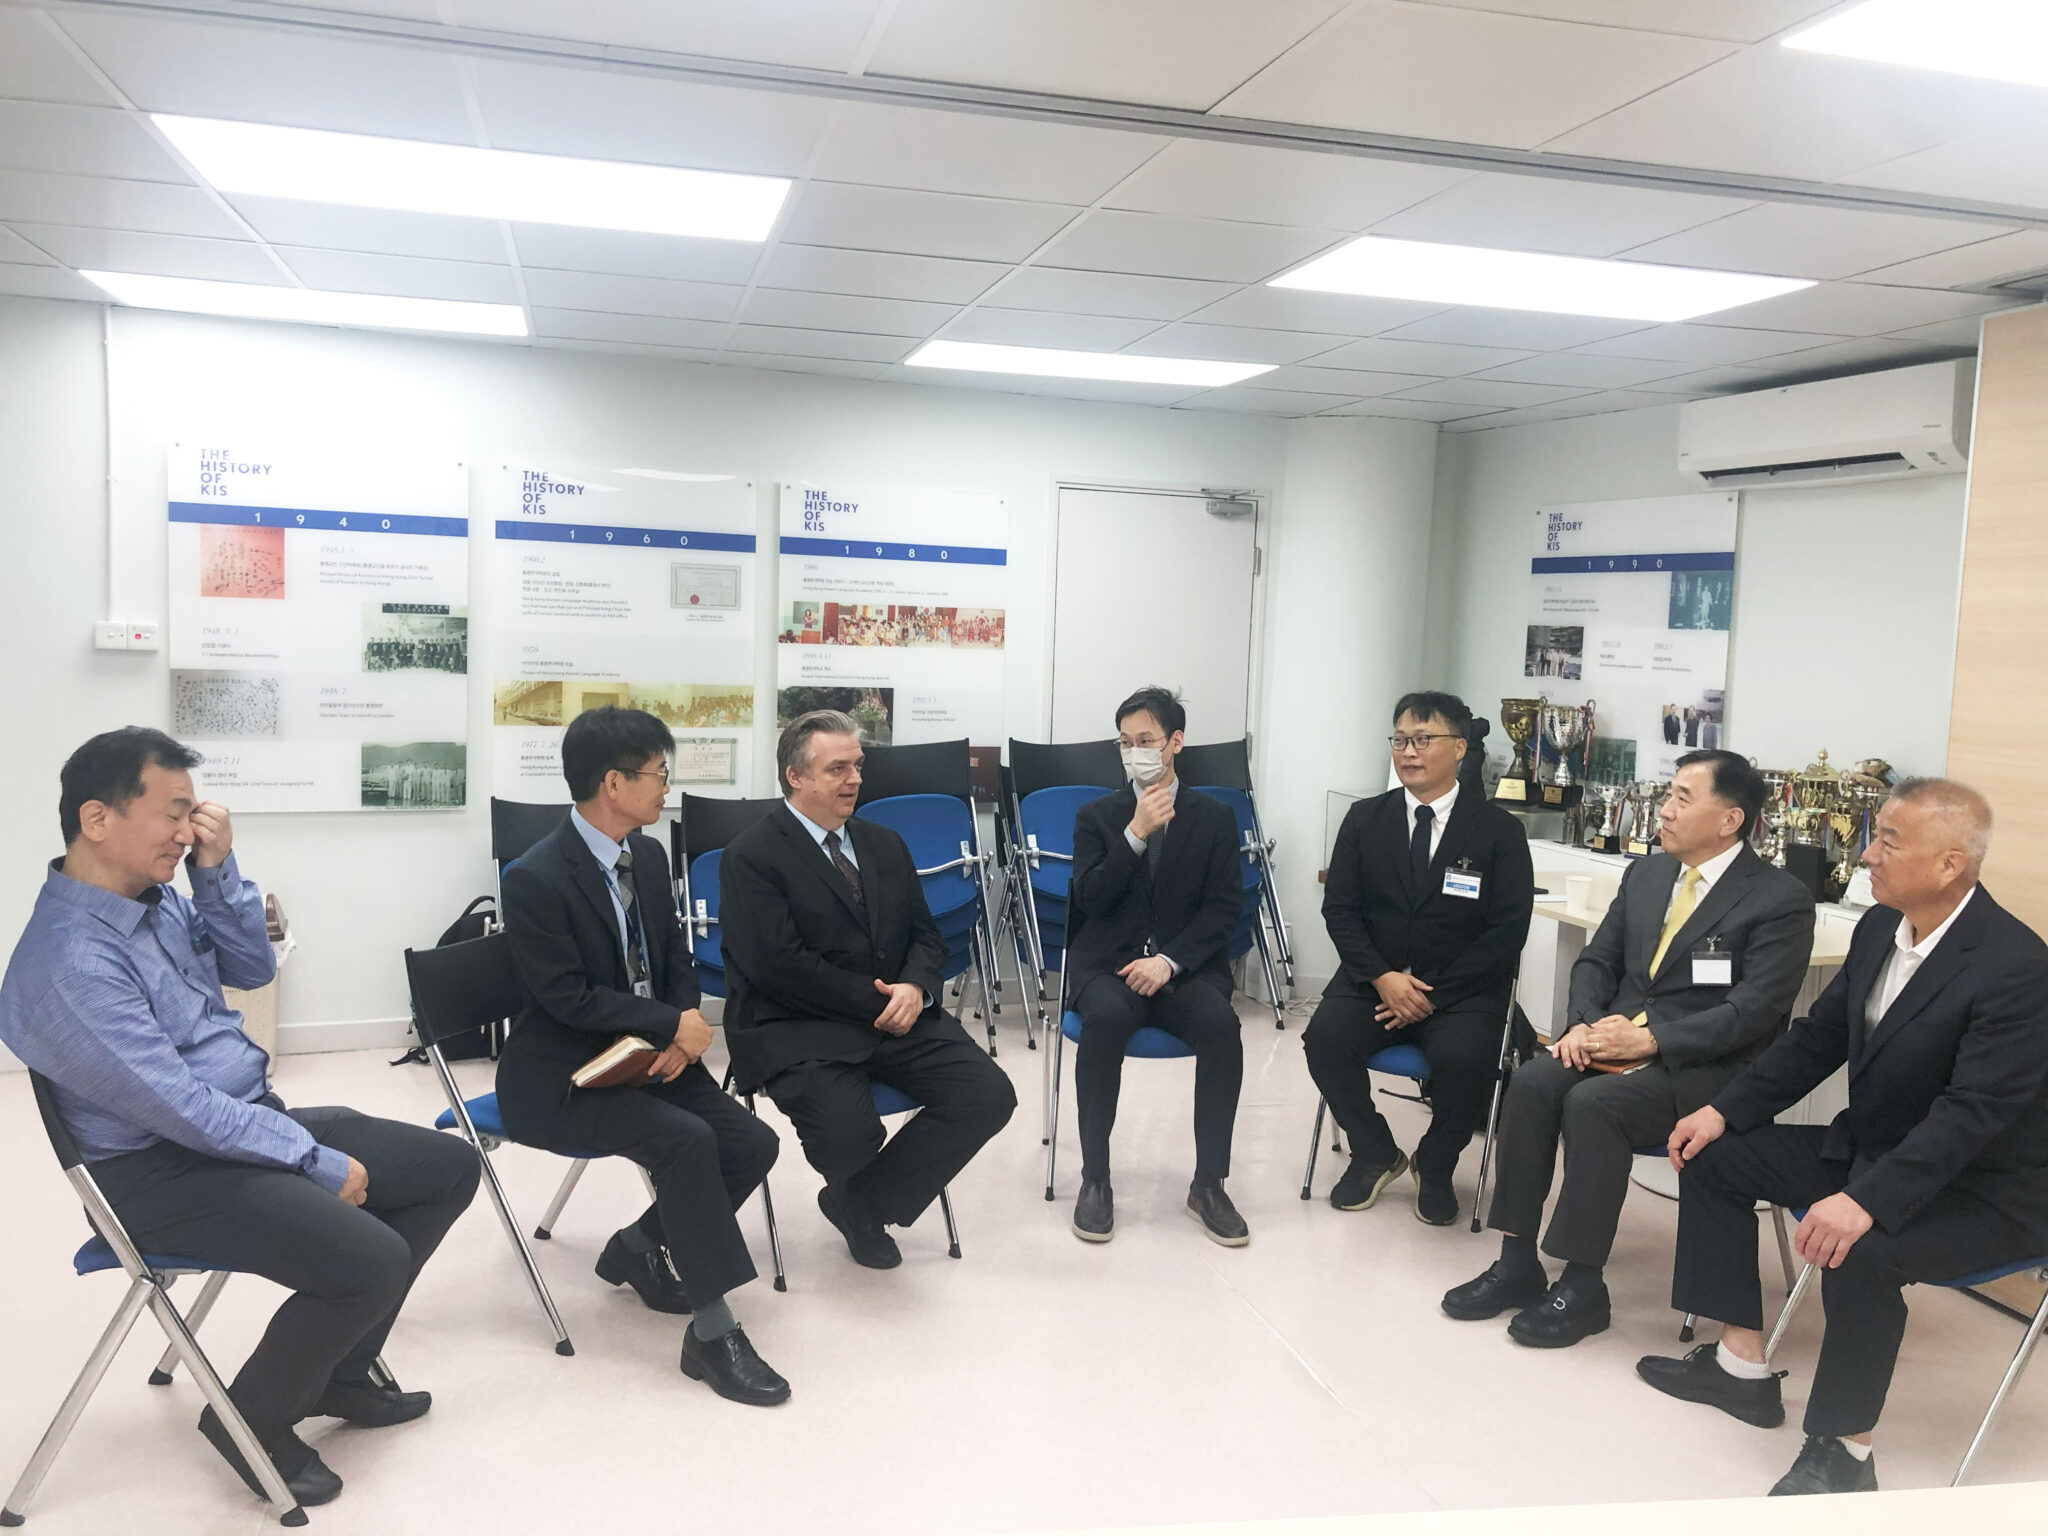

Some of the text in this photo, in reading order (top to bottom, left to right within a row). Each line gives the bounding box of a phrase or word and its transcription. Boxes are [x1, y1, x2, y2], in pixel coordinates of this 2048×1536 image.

[201, 448, 229, 460] THE
[201, 461, 272, 475] HISTORY
[201, 472, 222, 484] OF
[523, 470, 549, 482] THE
[201, 484, 228, 496] KIS
[523, 482, 585, 495] HISTORY
[523, 493, 542, 504] OF
[804, 490, 828, 501] THE
[523, 504, 547, 515] KIS
[804, 501, 859, 513] HISTORY
[804, 511, 821, 521] OF
[1548, 513, 1563, 522] THE
[804, 521, 825, 532] KIS
[1548, 521, 1583, 532] HISTORY
[1547, 532, 1558, 542] OF
[1547, 542, 1560, 551] KIS
